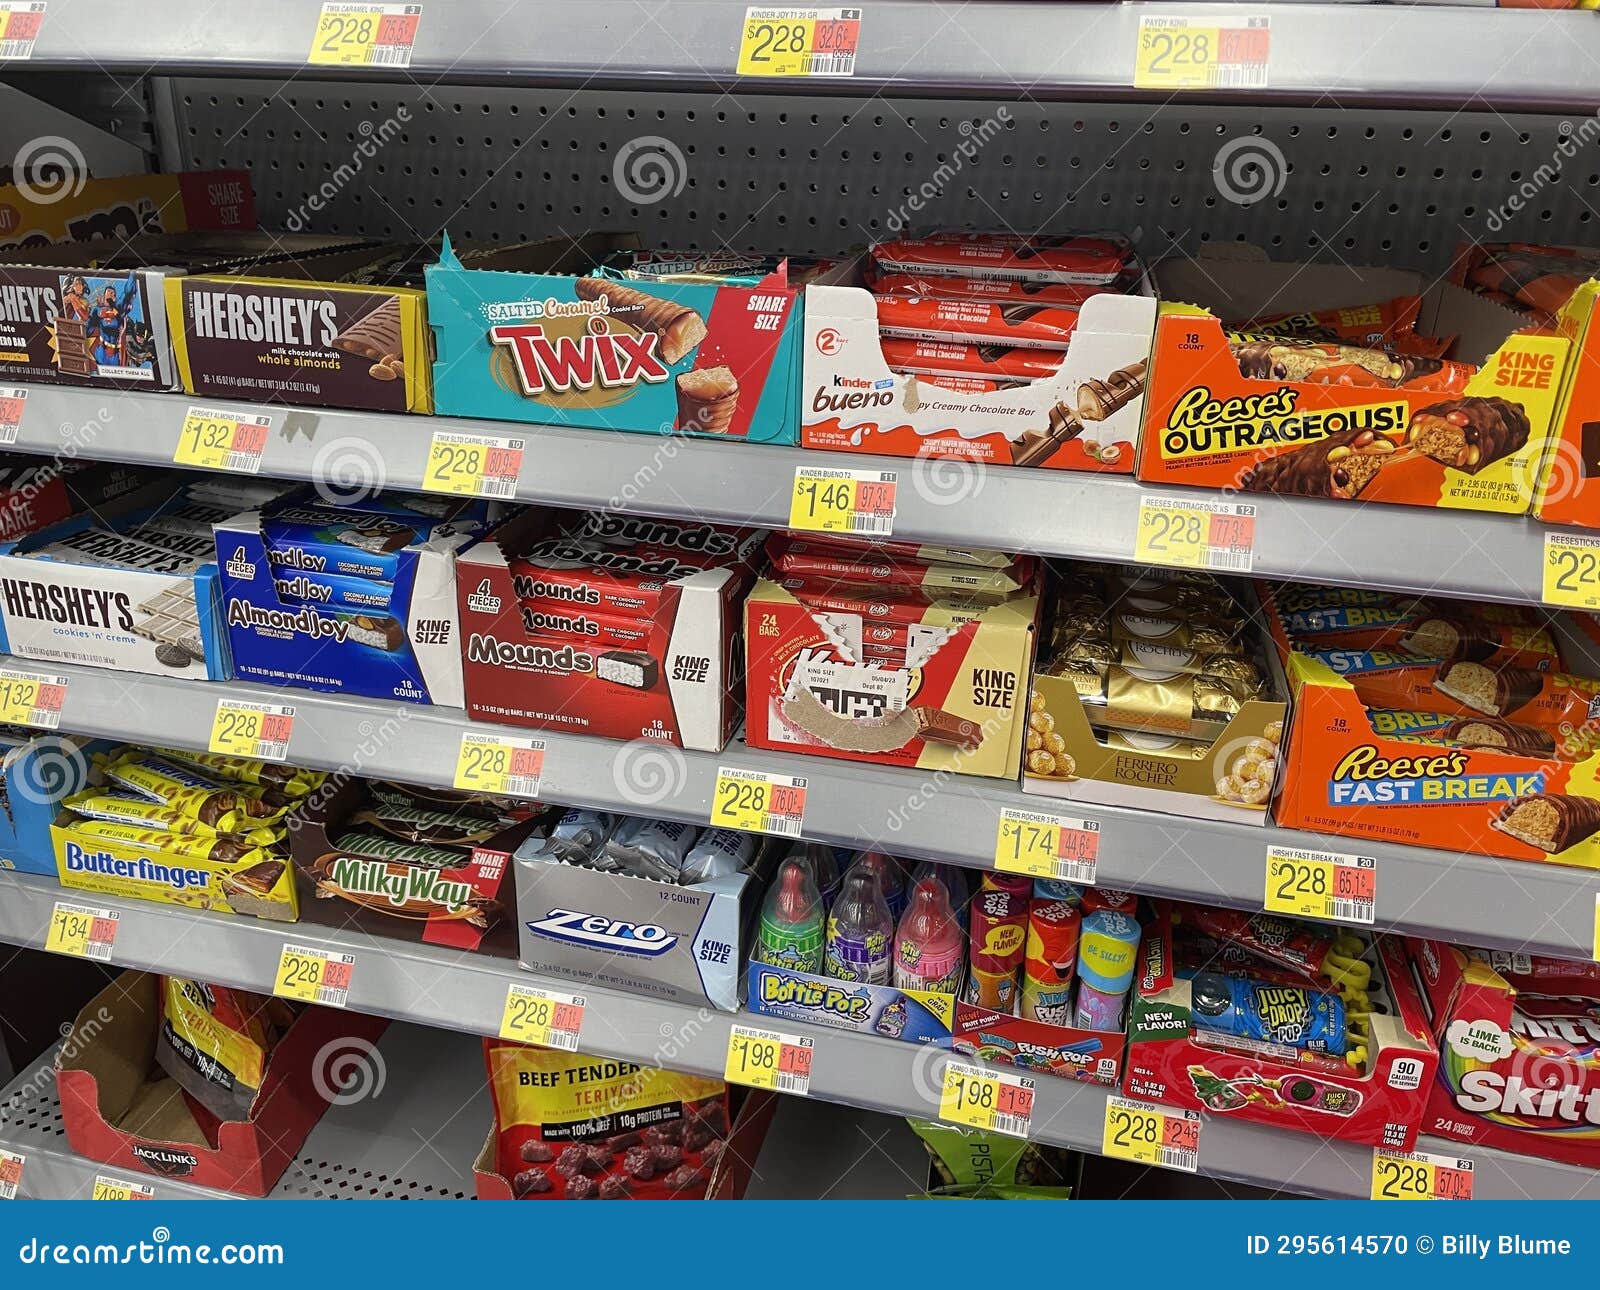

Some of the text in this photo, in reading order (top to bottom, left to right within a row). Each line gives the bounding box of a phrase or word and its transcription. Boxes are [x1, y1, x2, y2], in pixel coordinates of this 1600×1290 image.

[751, 10, 775, 18] KINDER
[776, 11, 789, 19] JOY
[207, 182, 245, 207] SHARE
[220, 206, 241, 225] SIZE
[487, 293, 645, 319] SALTED Caramel Cookie Bars
[747, 294, 787, 313] SHARE
[193, 291, 338, 348] HERSHEY'S
[754, 313, 781, 331] SIZE
[1185, 332, 1200, 345] 18
[271, 347, 340, 359] milk chocolate with
[1177, 342, 1206, 352] COUNT
[257, 354, 341, 370] whole almonds
[1499, 350, 1556, 373] KING
[833, 373, 872, 389] kinder
[1495, 367, 1552, 390] SIZE
[812, 385, 894, 413] bueno
[933, 400, 967, 416] Creamy
[969, 402, 1016, 417] Chocolate
[1017, 406, 1036, 417] Bar
[1167, 386, 1303, 430] Reese's
[1164, 404, 1406, 455] OUTRAGEOUS!
[800, 469, 842, 480] KINDER BUENO
[234, 547, 245, 563] 4
[226, 561, 255, 575] PIECES
[477, 579, 490, 597] 4
[513, 576, 600, 605] Mounds
[2, 578, 134, 632] HERSHEY'S
[468, 595, 500, 608] PIECES
[416, 619, 450, 633] KING
[761, 613, 777, 627] 24
[53, 626, 90, 639] cookies
[105, 633, 137, 645] creme
[415, 631, 449, 645] SIZE
[759, 625, 780, 637] BARS
[468, 633, 593, 673] Mounds
[674, 655, 710, 670] KING
[672, 668, 706, 683] SIZE
[972, 668, 1016, 690] KING
[401, 680, 412, 689] 18
[393, 687, 423, 699] COUNT
[973, 687, 1012, 709] SIZE
[651, 719, 663, 729] 18
[1326, 725, 1351, 734] COUNT
[1333, 717, 1347, 727] 18
[641, 727, 673, 740] COUNT
[1116, 755, 1178, 775] FERRERO
[1331, 745, 1471, 782] Reese's
[1115, 766, 1176, 786] ROCHER
[1333, 774, 1539, 803] FAST BREAK
[472, 852, 505, 868] SHARE
[1273, 849, 1332, 863] HRSHY FAST BREAK
[1361, 858, 1372, 868] 20
[65, 841, 210, 890] Butterfinger
[478, 866, 501, 881] SIZE
[659, 890, 701, 906] 12 COUNT
[1032, 900, 1069, 917] PUSH
[1046, 907, 1074, 923] POP
[701, 939, 732, 954] KING
[1087, 944, 1128, 963] BE SILLY!
[699, 949, 729, 965] SIZE
[1257, 987, 1308, 1009] JUICY
[962, 1014, 1000, 1029] FRUIT PUNCH
[1144, 1011, 1173, 1023] NEW
[1266, 1003, 1304, 1026] DROP
[1136, 1018, 1187, 1033] FLAVOR!
[1277, 1024, 1302, 1042] POP
[1468, 1027, 1502, 1044] LIME
[1460, 1036, 1502, 1054] IS BACK!
[1016, 1042, 1059, 1060] PUSH
[1058, 1050, 1095, 1065] POP
[1101, 1059, 1113, 1070] 60
[1396, 1062, 1415, 1075] 90
[519, 1071, 560, 1087] BEEF
[1390, 1072, 1419, 1083] CALORIES
[571, 1122, 595, 1137] 100%
[620, 1114, 636, 1129] 10g
[637, 1110, 662, 1124] PROTEIN
[1434, 1118, 1452, 1131] 24
[132, 1144, 198, 1167] JACK LINK'S
[1460, 1160, 1470, 1169] 29
